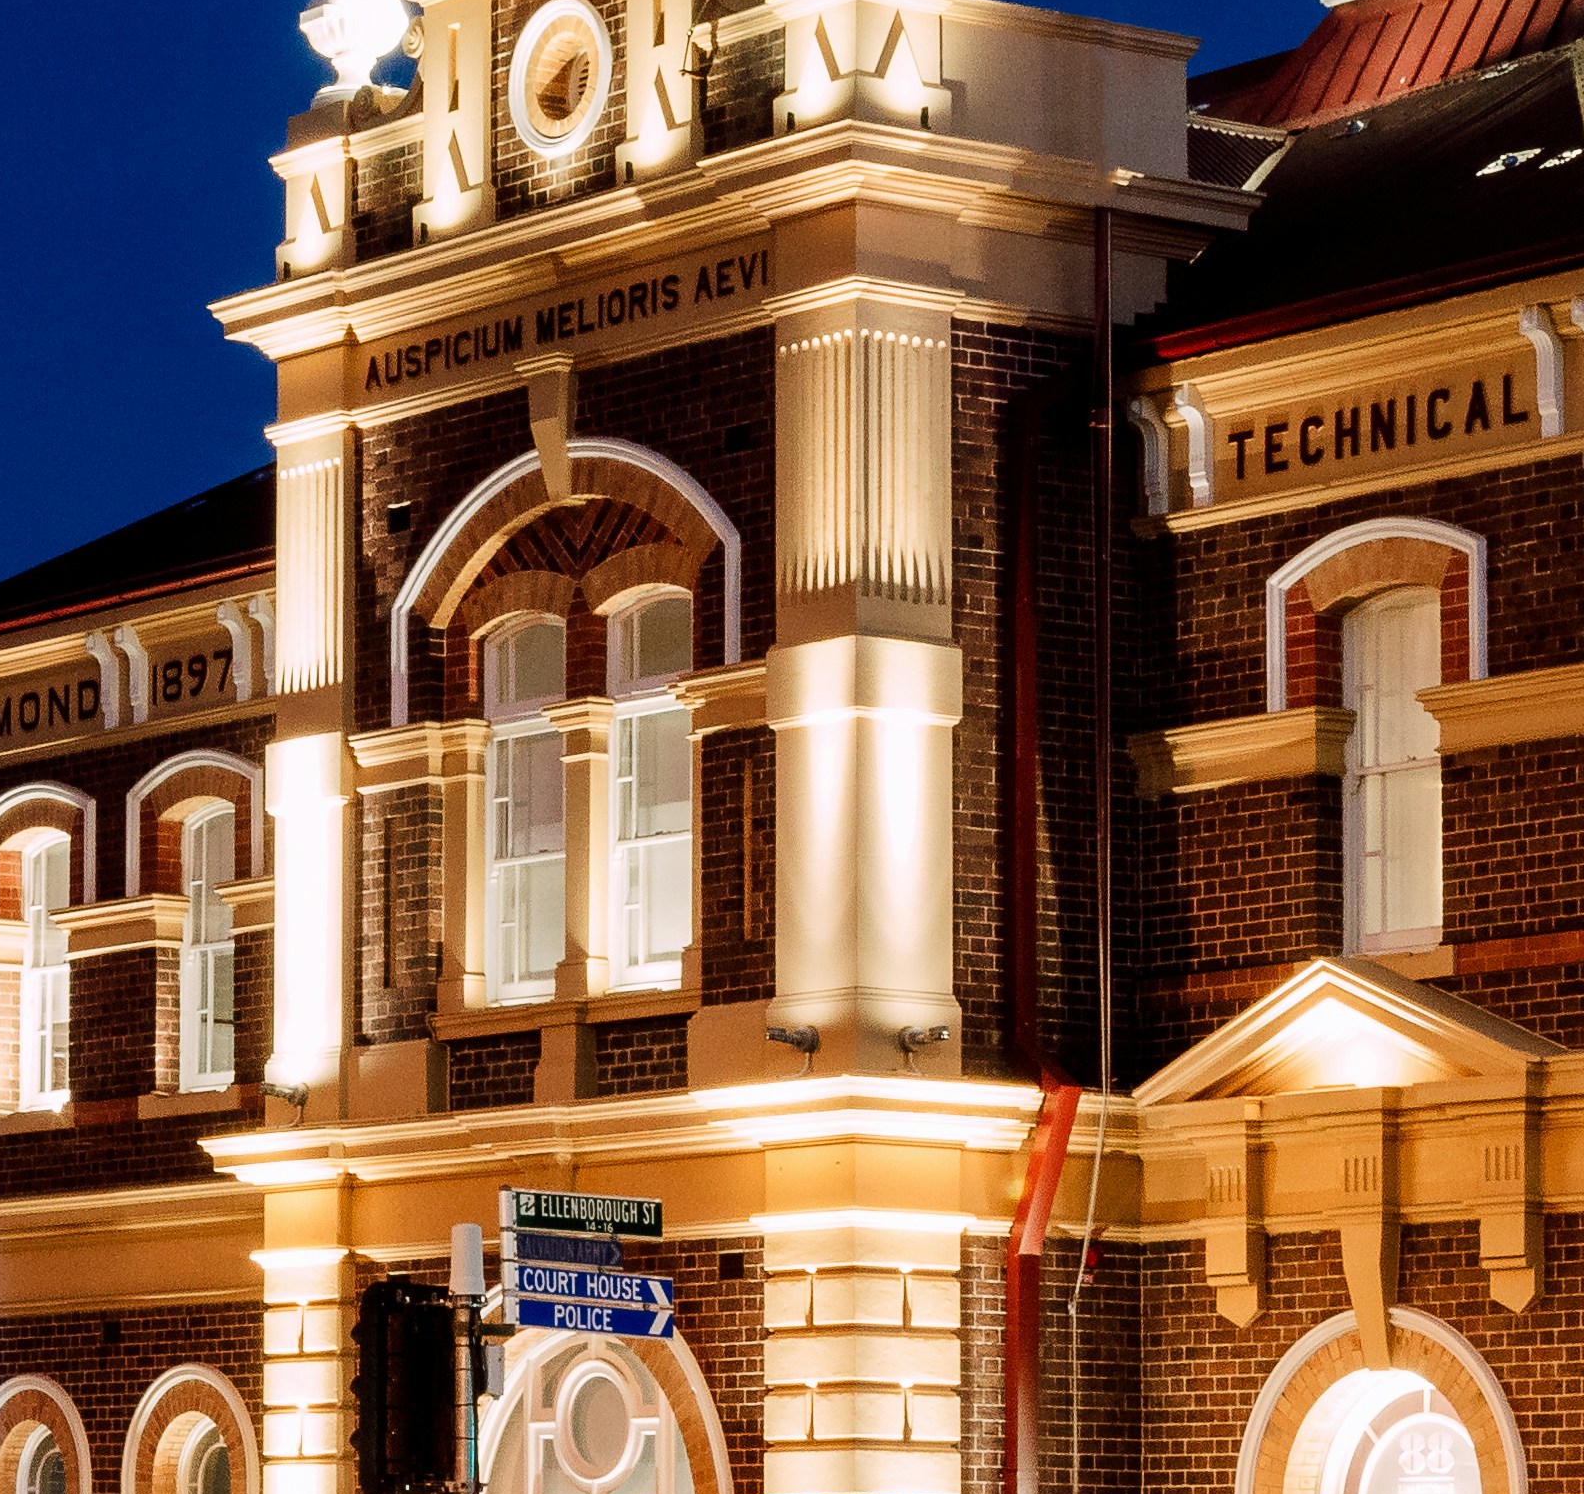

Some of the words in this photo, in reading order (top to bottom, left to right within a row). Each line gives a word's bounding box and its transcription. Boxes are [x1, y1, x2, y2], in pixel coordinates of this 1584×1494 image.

[364, 315, 523, 393] AUSPICIUM
[535, 274, 680, 345] MELIORIS
[694, 249, 768, 304] AEVI
[1227, 373, 1531, 481] TECHNICAL
[150, 649, 234, 707] 1897
[540, 1195, 638, 1223] ELLENBOROUGH
[643, 1203, 656, 1225] ST
[577, 1242, 607, 1265] ARMY
[523, 1268, 578, 1295] COURT
[586, 1273, 643, 1301] HOUSE
[554, 1305, 613, 1332] POLICE
